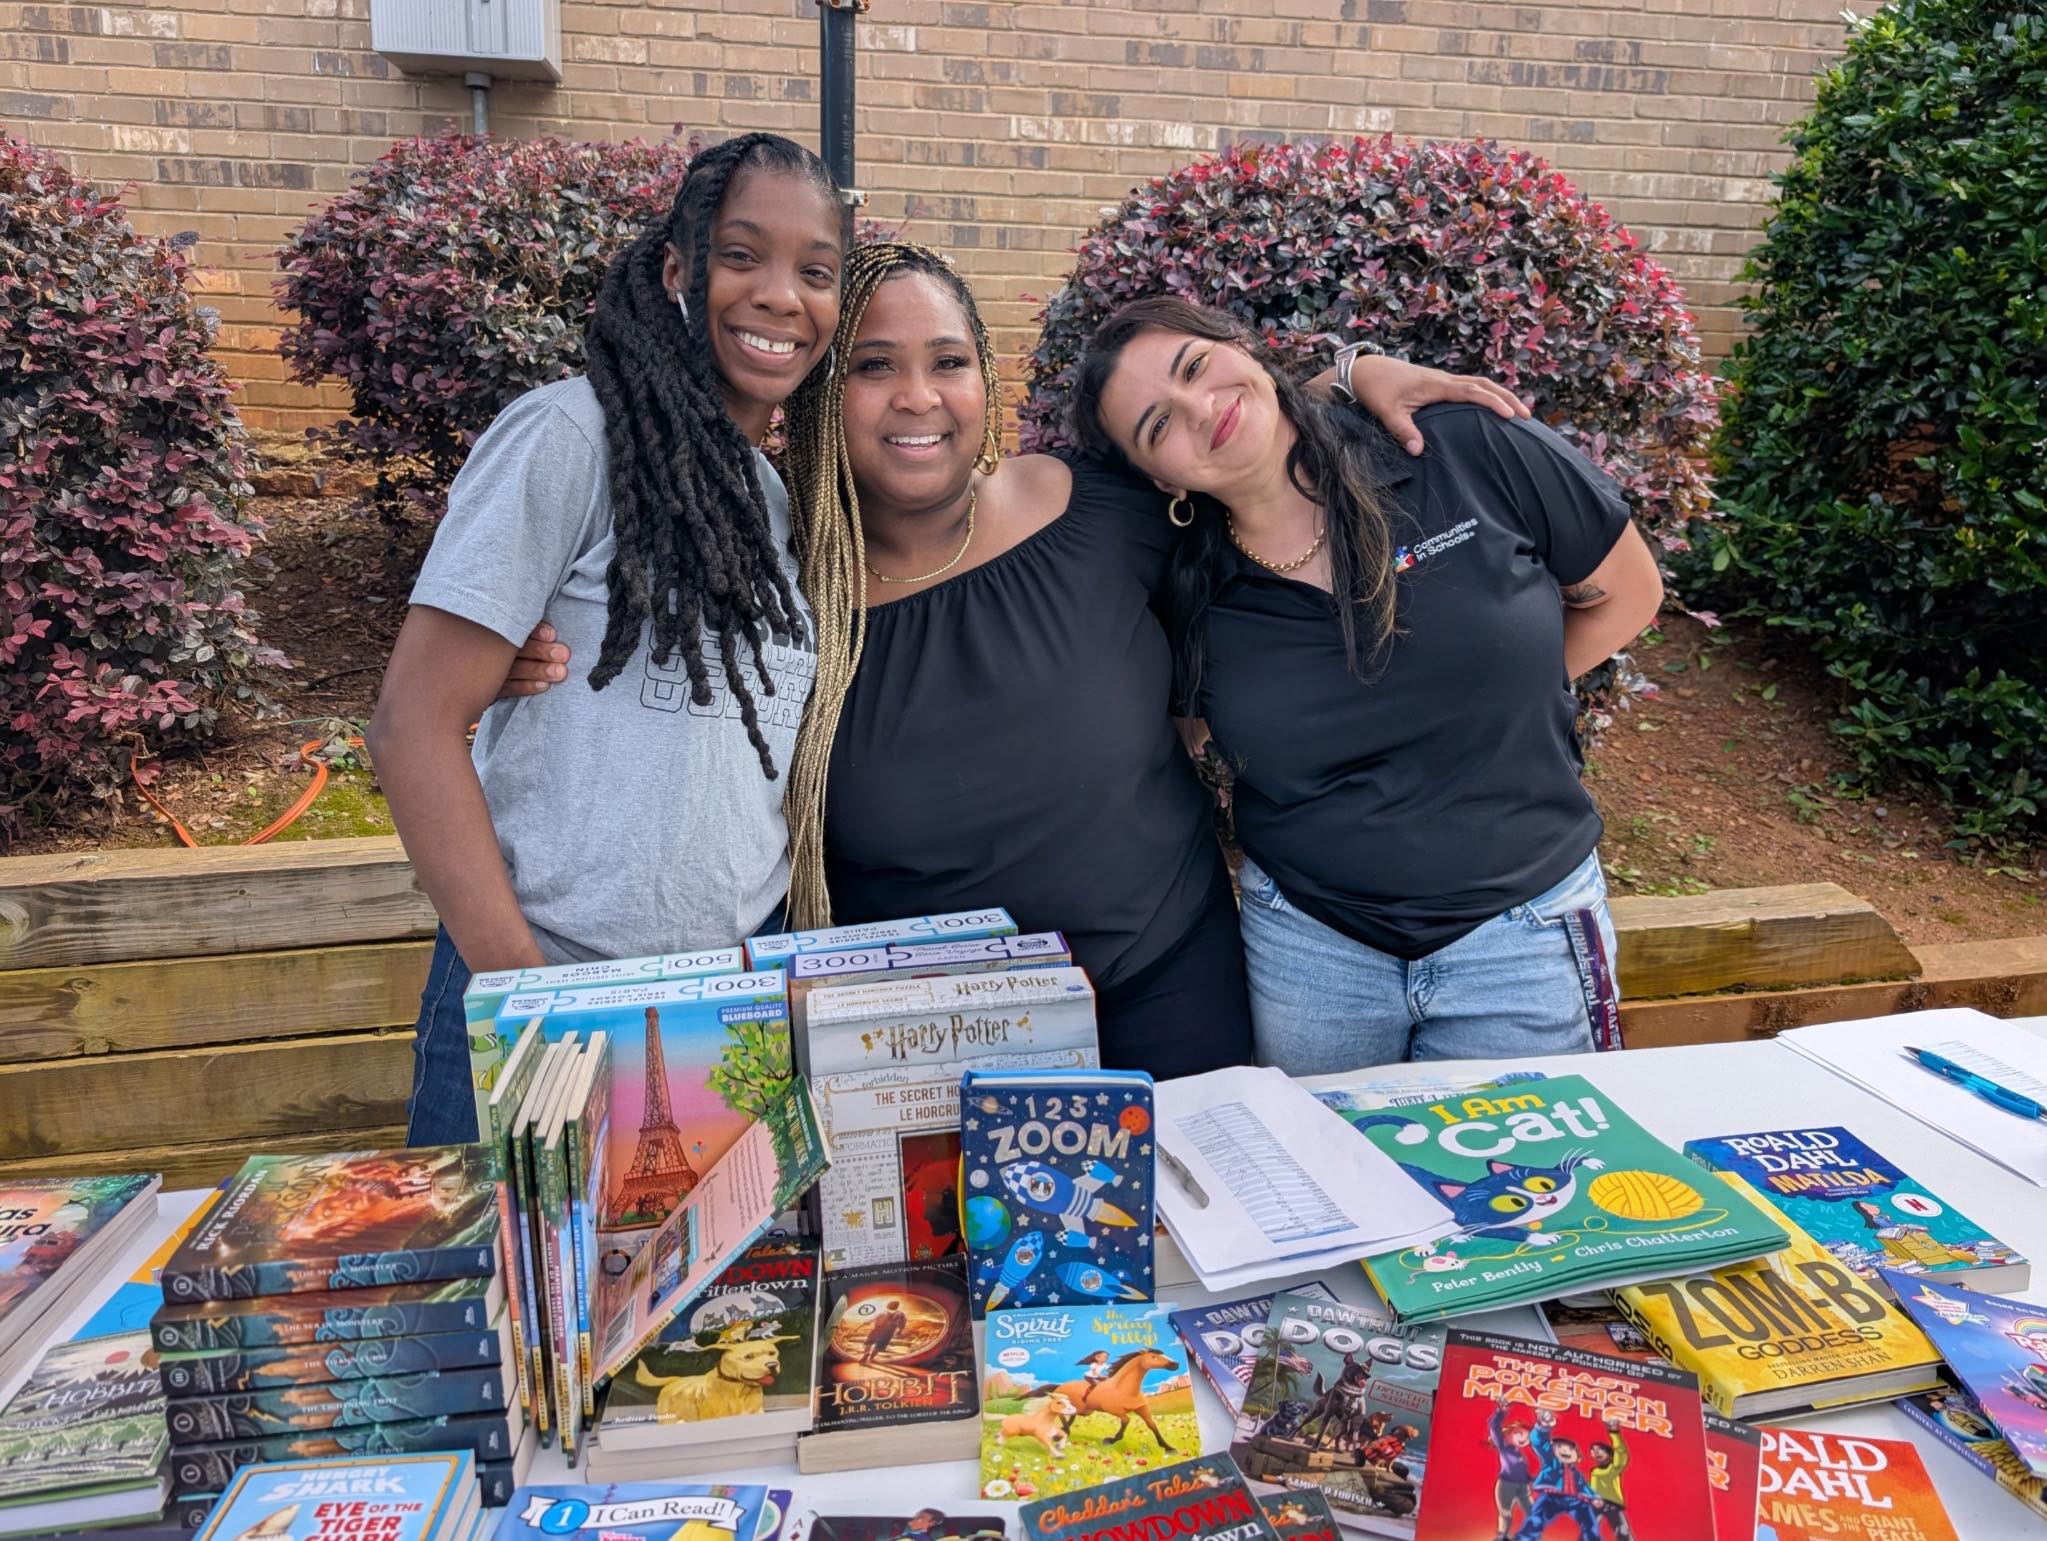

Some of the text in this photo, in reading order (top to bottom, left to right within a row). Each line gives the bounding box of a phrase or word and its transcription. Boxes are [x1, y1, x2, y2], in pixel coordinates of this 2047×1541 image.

[1413, 518, 1479, 554] Communities
[943, 912, 1004, 928] 300
[675, 952, 733, 971] 500
[803, 953, 870, 970] 300
[609, 985, 648, 996] PARIS
[714, 974, 777, 993] 300
[954, 976, 1059, 997] Harry Potter
[721, 1002, 783, 1015] PREMIUM QUALITY
[721, 1008, 783, 1024] BLUEBOARD
[889, 1013, 1011, 1061] Harry Potter
[875, 1086, 942, 1106] THE SECRET
[900, 1109, 913, 1121] LE
[1025, 1096, 1087, 1121] 1 2 3
[1429, 1103, 1460, 1126] I
[1464, 1091, 1547, 1120] Am
[1437, 1096, 1612, 1158] Cat!
[987, 1120, 1132, 1164] ZOOM
[1751, 1149, 1859, 1173] DAHL
[1768, 1167, 1892, 1194] MATILDA
[196, 1215, 228, 1252] RICK
[223, 1168, 268, 1218] RIORDAN
[1574, 1224, 1740, 1260] Chris Chatterton
[545, 1241, 554, 1268] SUNSET
[298, 1270, 314, 1279] THE
[314, 1268, 333, 1277] SEA
[575, 1271, 583, 1289] WITH
[850, 1271, 880, 1279] MAJOR
[882, 1266, 921, 1275] MOTION
[922, 1262, 959, 1271] PICTURE
[1431, 1258, 1543, 1293] Peter Bently
[553, 1264, 564, 1338] PIRATES PAST NOON
[1641, 1261, 1888, 1352] ZOM-B
[283, 1323, 301, 1333] THE
[300, 1322, 319, 1331] SEA
[995, 1313, 1075, 1339] Spirit
[1306, 1303, 1424, 1342] PAWTRIOT
[513, 1325, 521, 1345] MARY
[611, 1315, 671, 1373] MARY POPE OSBORNE
[1279, 1315, 1439, 1371] DOGS
[1737, 1325, 1884, 1361] GODDESS
[533, 1351, 541, 1371] MARY
[1458, 1332, 1482, 1344] THIS
[1484, 1335, 1512, 1348] BOOK
[1526, 1341, 1559, 1356] NOT
[1564, 1349, 1665, 1377] AUTHORISED
[1666, 1372, 1682, 1381] BY
[1489, 1342, 1509, 1352] THE
[1510, 1345, 1552, 1360] MAKERS
[1553, 1354, 1567, 1363] OF
[302, 1359, 322, 1370] THE
[1493, 1355, 1641, 1394] THE LAST
[1772, 1351, 1893, 1380] DARREN SHAN
[42, 1379, 155, 1409] HOBBIT
[813, 1369, 973, 1420] HOBBIT
[300, 1404, 320, 1415] THE
[839, 1401, 934, 1416] J.R.R. TOLKIEN
[1462, 1379, 1674, 1439] MASTER
[1901, 1402, 1988, 1471] CARNIVAL AT CANDLELIGHT
[301, 1467, 391, 1482] HUNGRY
[258, 1475, 407, 1502] SHARK
[1333, 1488, 1373, 1507] FORTSCH
[314, 1501, 423, 1518] EYE OF THE
[592, 1500, 728, 1523] I Can Read!
[1038, 1488, 1146, 1534] Cheddar's
[1147, 1473, 1204, 1501] Tales
[319, 1515, 402, 1535] TIGER
[1839, 1514, 1861, 1525] AND
[1841, 1523, 1860, 1532] THE
[1860, 1513, 1917, 1532] GIANT
[1867, 1529, 1927, 1541] PEACH
